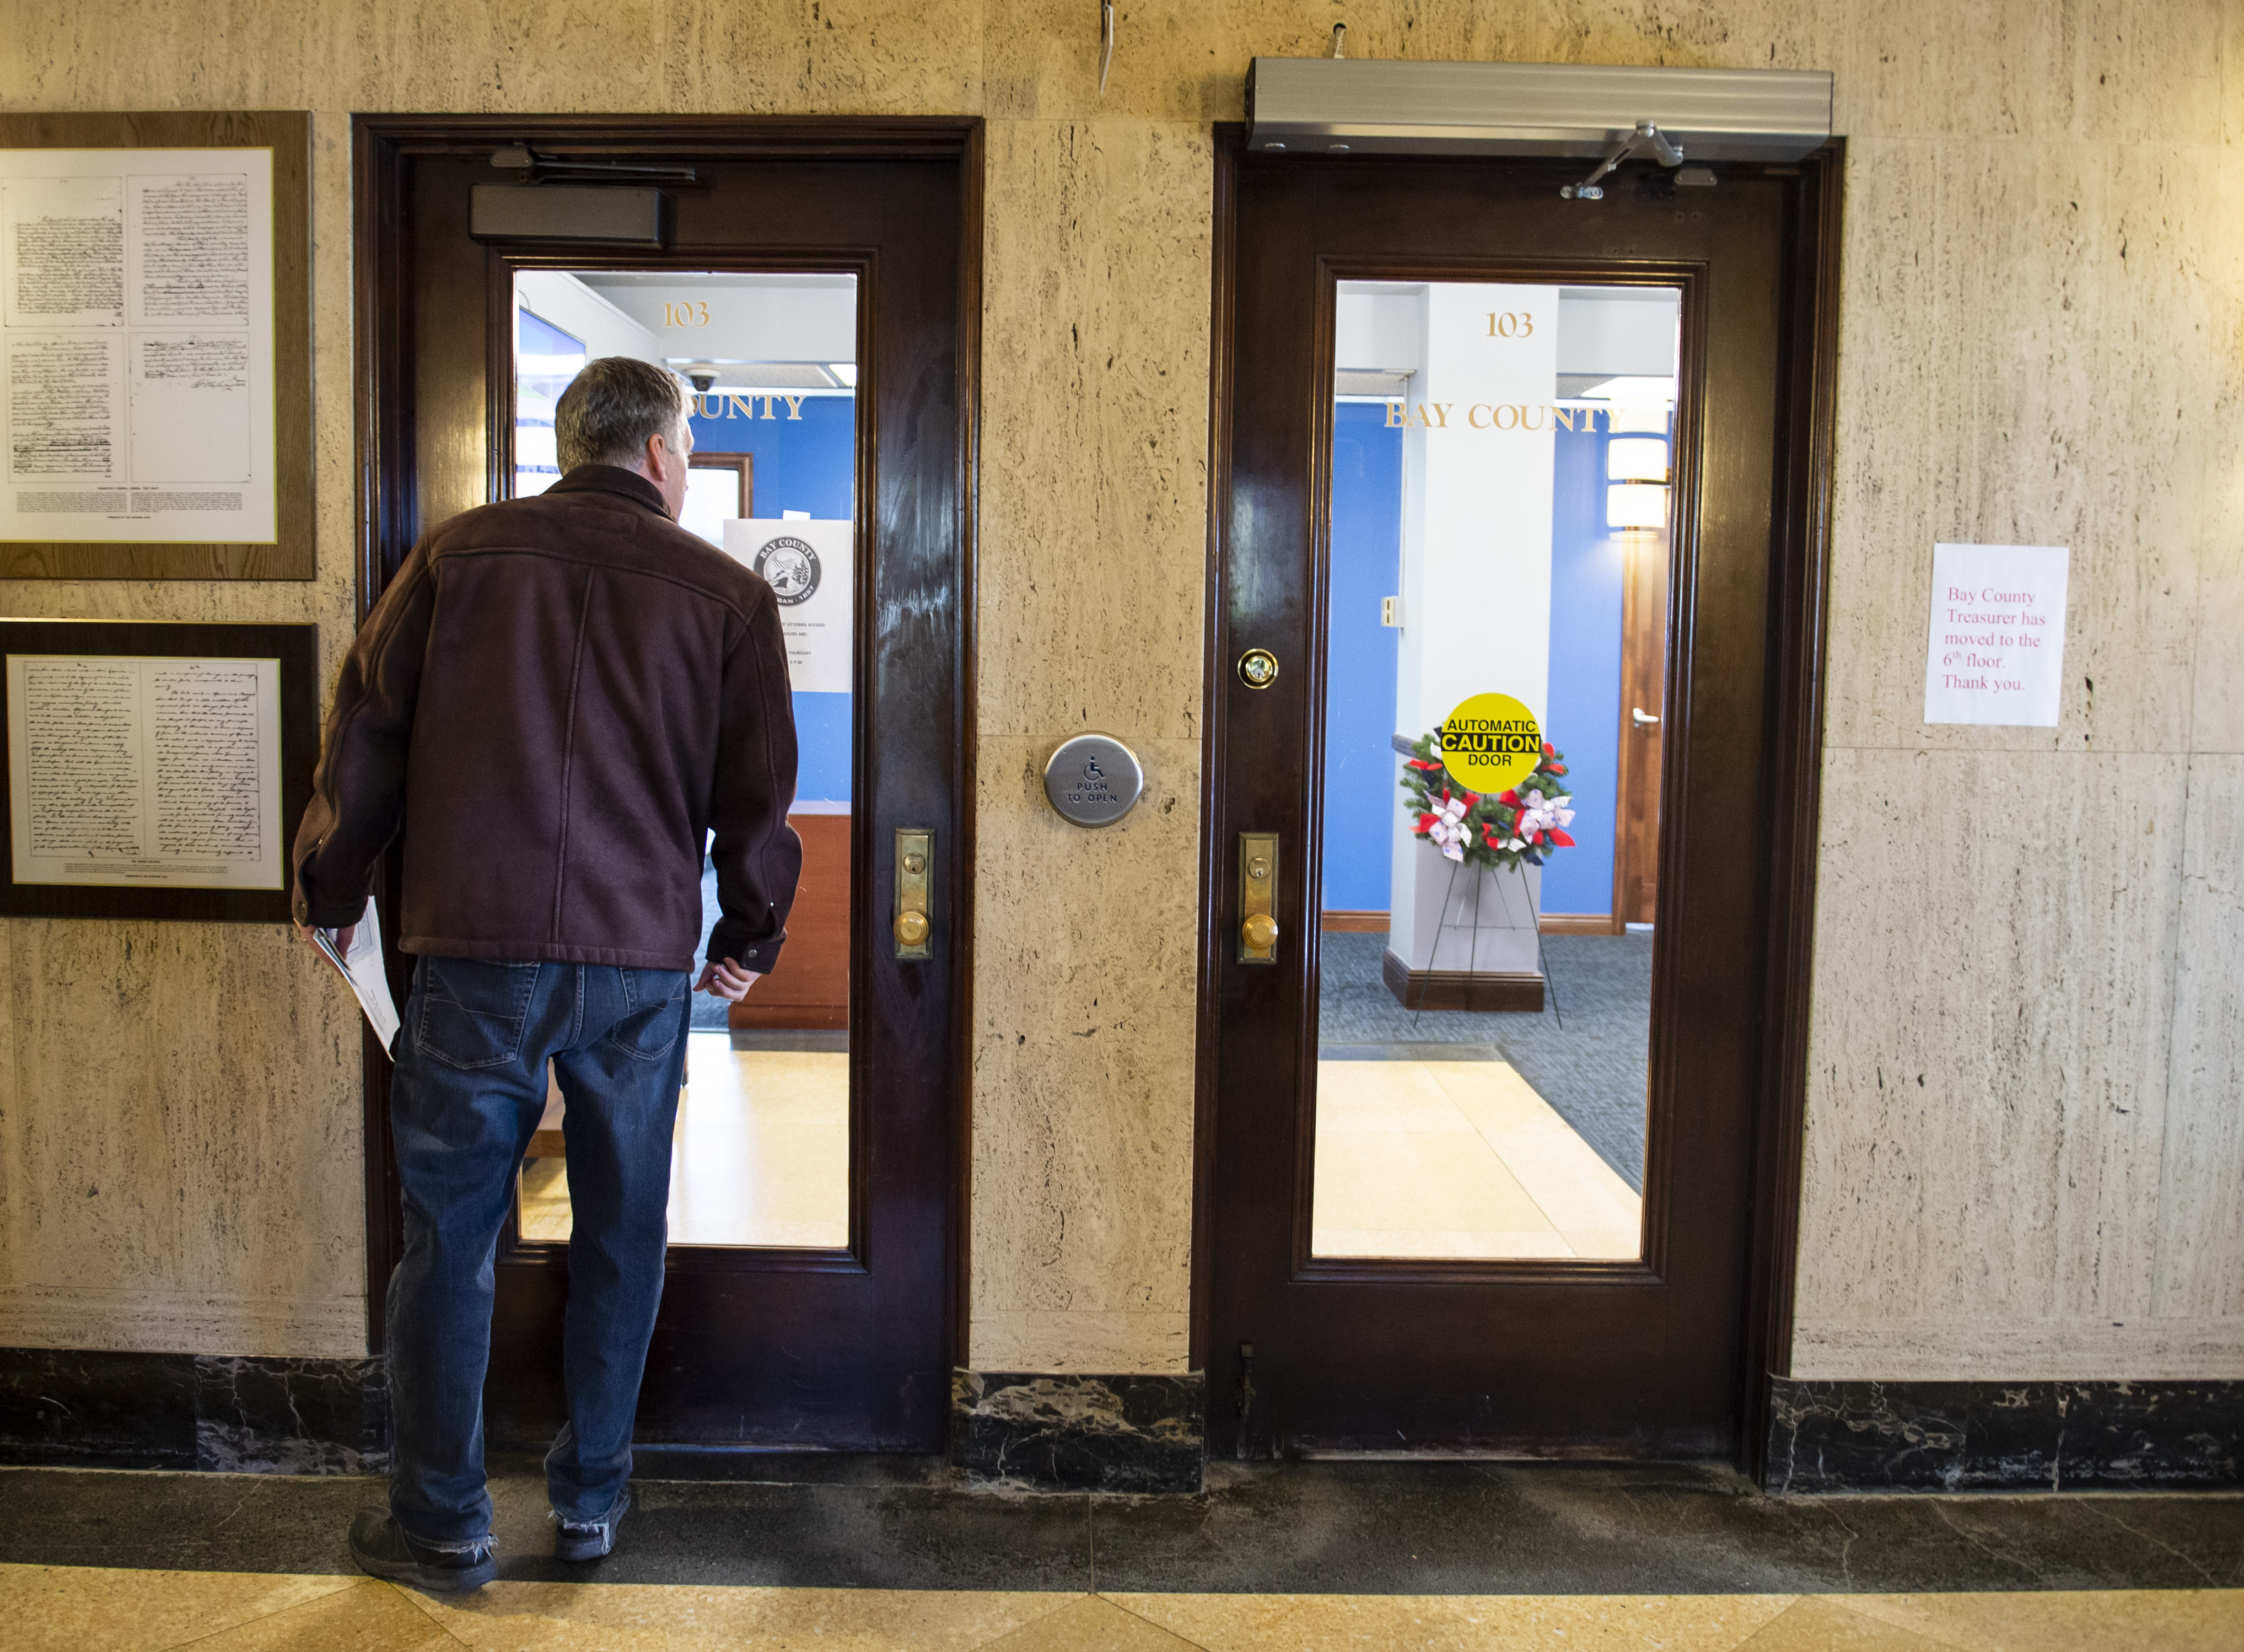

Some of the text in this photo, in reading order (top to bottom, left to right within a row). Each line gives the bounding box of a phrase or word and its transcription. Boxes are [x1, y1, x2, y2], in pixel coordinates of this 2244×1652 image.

[663, 302, 710, 327] 103
[1486, 311, 1533, 338] 103
[1384, 402, 1627, 434] BAY COUNTY
[760, 539, 817, 561] BAY COUNTY
[1948, 587, 2036, 607] Bay County
[1947, 609, 2046, 625] Treasurer has
[1945, 632, 2041, 647] moved to the
[1943, 650, 2005, 668] 6th floor.
[1942, 674, 2025, 694] Thank you.
[1447, 719, 1536, 732] AUTOMATIC
[1441, 734, 1540, 752] CAUTION
[1468, 754, 1511, 766] DOOR
[1077, 783, 1107, 792] PUSH
[1067, 794, 1117, 803] TO OPEN
